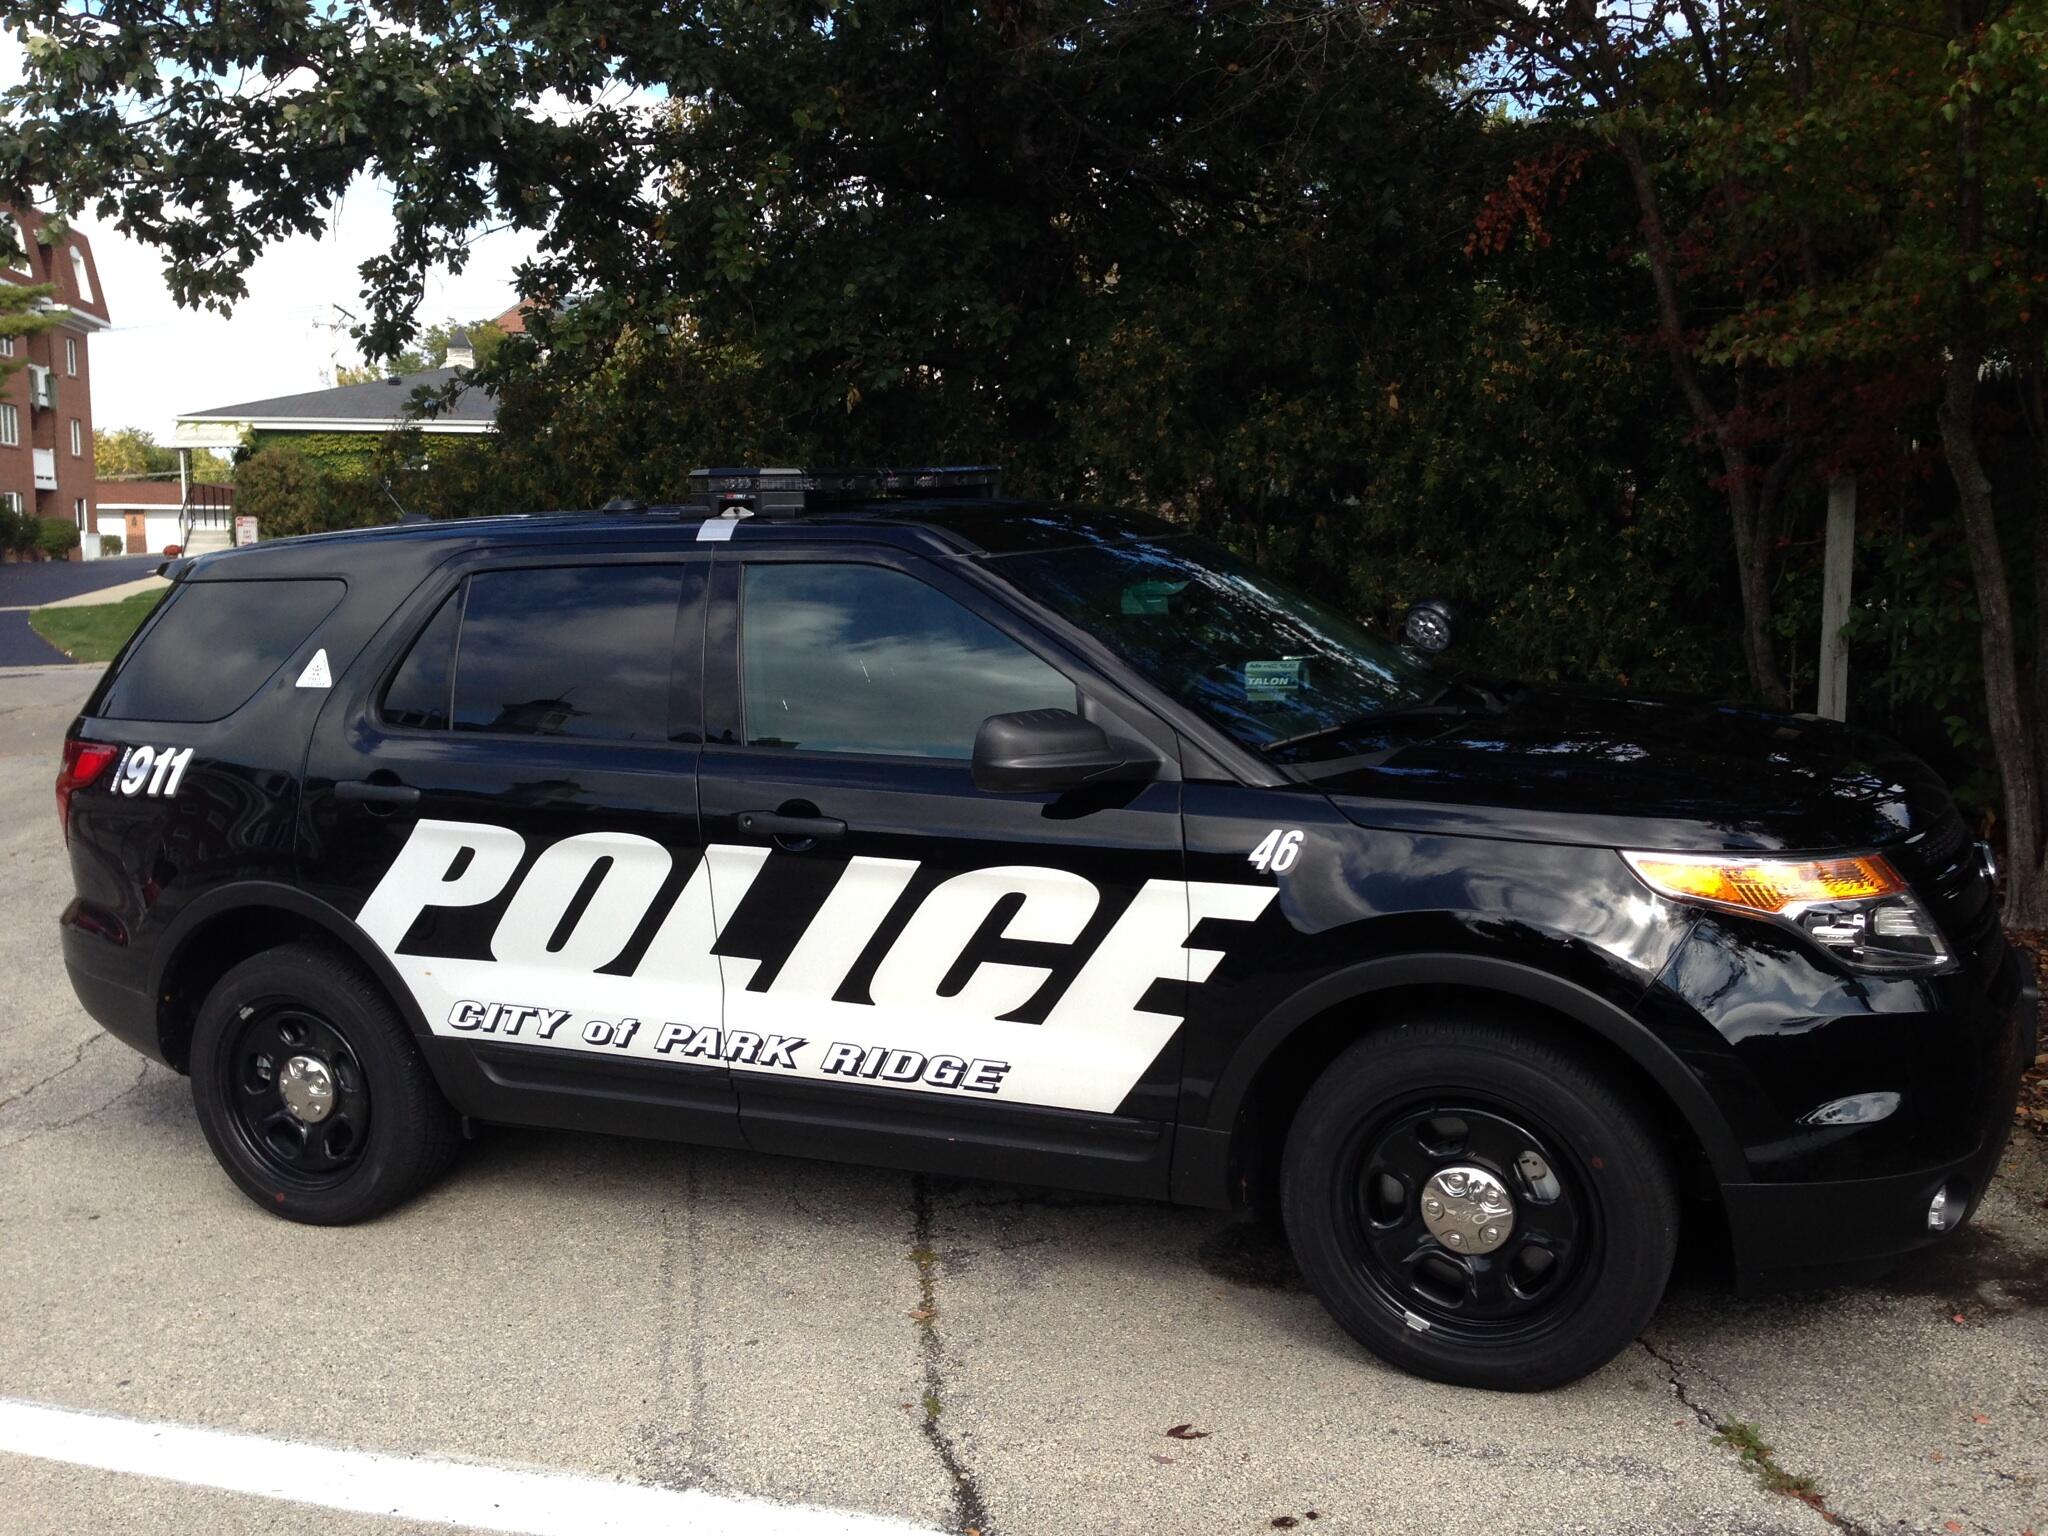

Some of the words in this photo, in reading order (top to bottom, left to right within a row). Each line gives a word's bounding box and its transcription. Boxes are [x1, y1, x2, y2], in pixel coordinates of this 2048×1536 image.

[1247, 677, 1289, 686] TALON
[120, 745, 195, 798] 911
[1247, 829, 1306, 874] 46
[355, 818, 1280, 1045] POLICE
[447, 999, 573, 1039] CITY
[581, 1017, 641, 1048] of
[654, 1022, 809, 1070] PARK
[821, 1041, 1012, 1094] RIDGE
